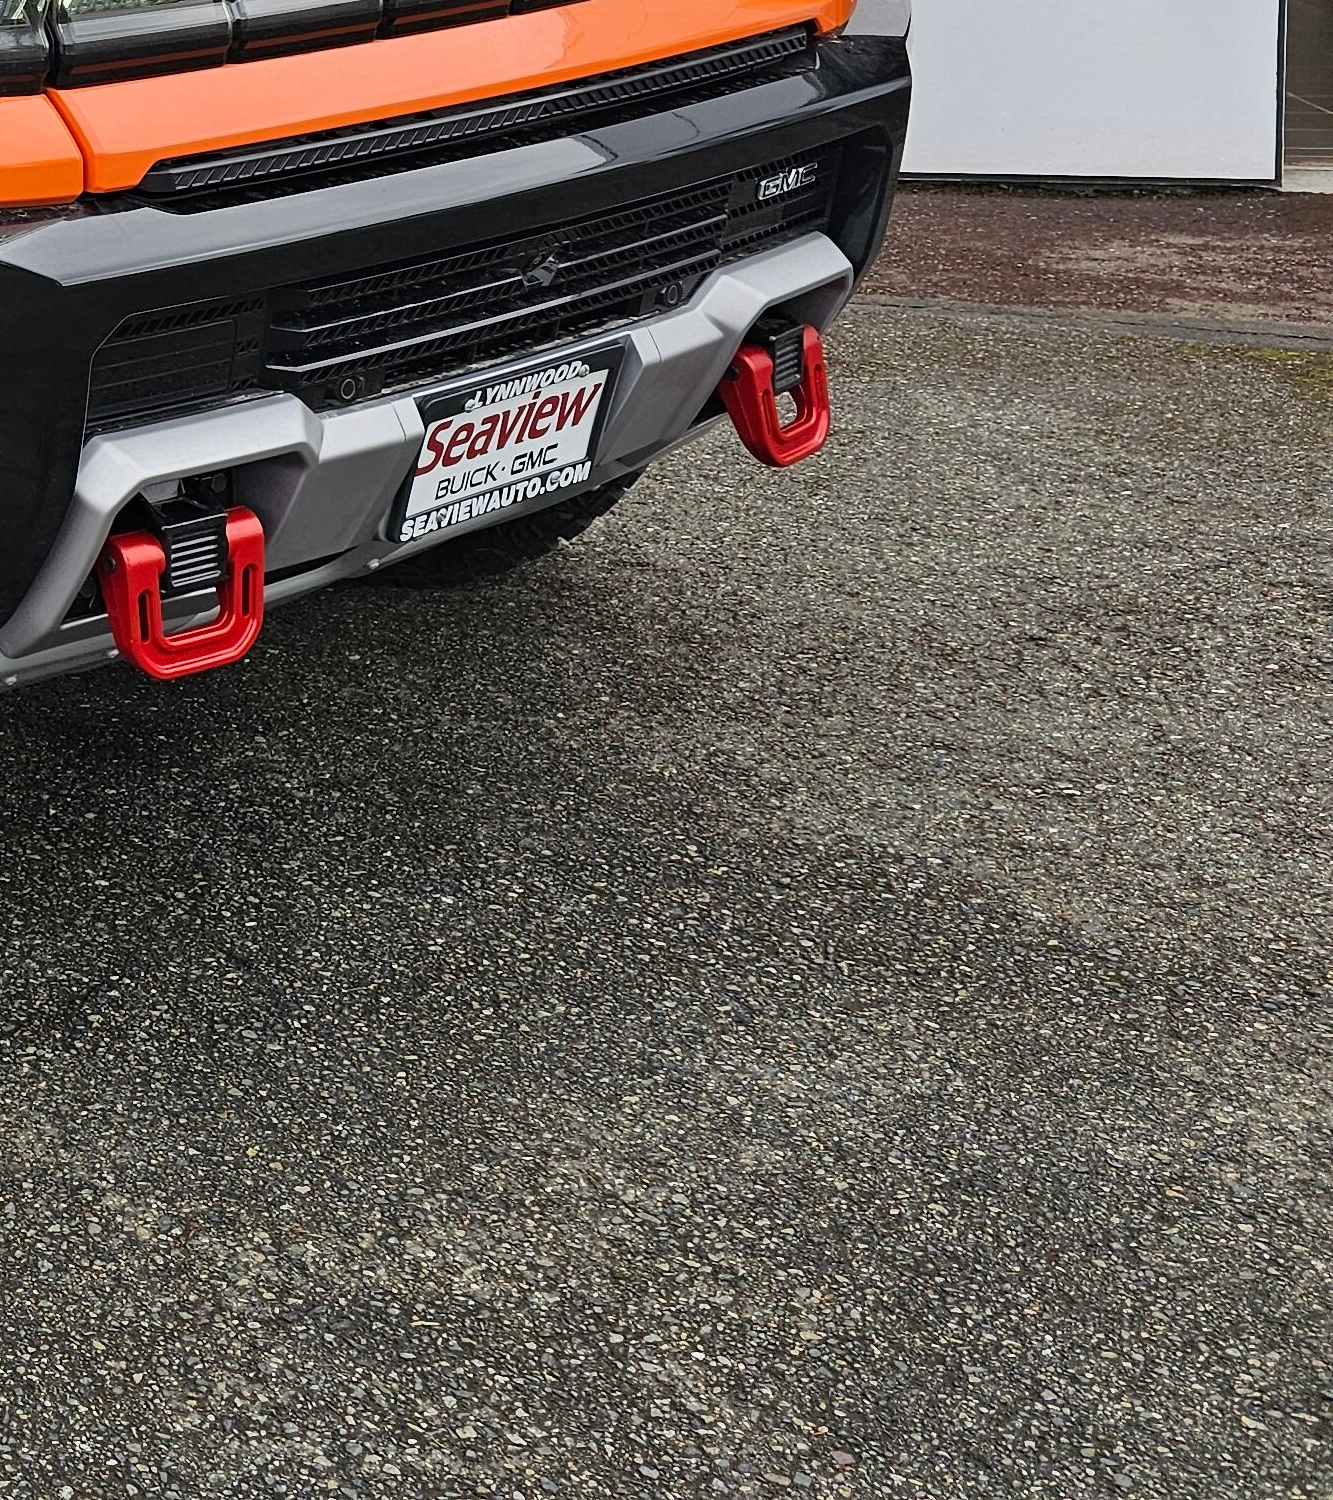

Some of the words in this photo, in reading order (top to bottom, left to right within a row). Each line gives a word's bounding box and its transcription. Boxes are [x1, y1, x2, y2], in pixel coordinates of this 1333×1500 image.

[757, 162, 818, 200] GMC
[474, 360, 583, 409] LYNNWOOD
[412, 382, 603, 477] Seaview
[434, 461, 501, 500] BUICK
[510, 442, 559, 475] GMC
[399, 461, 592, 542] SEAVIEWAUTO.COM
